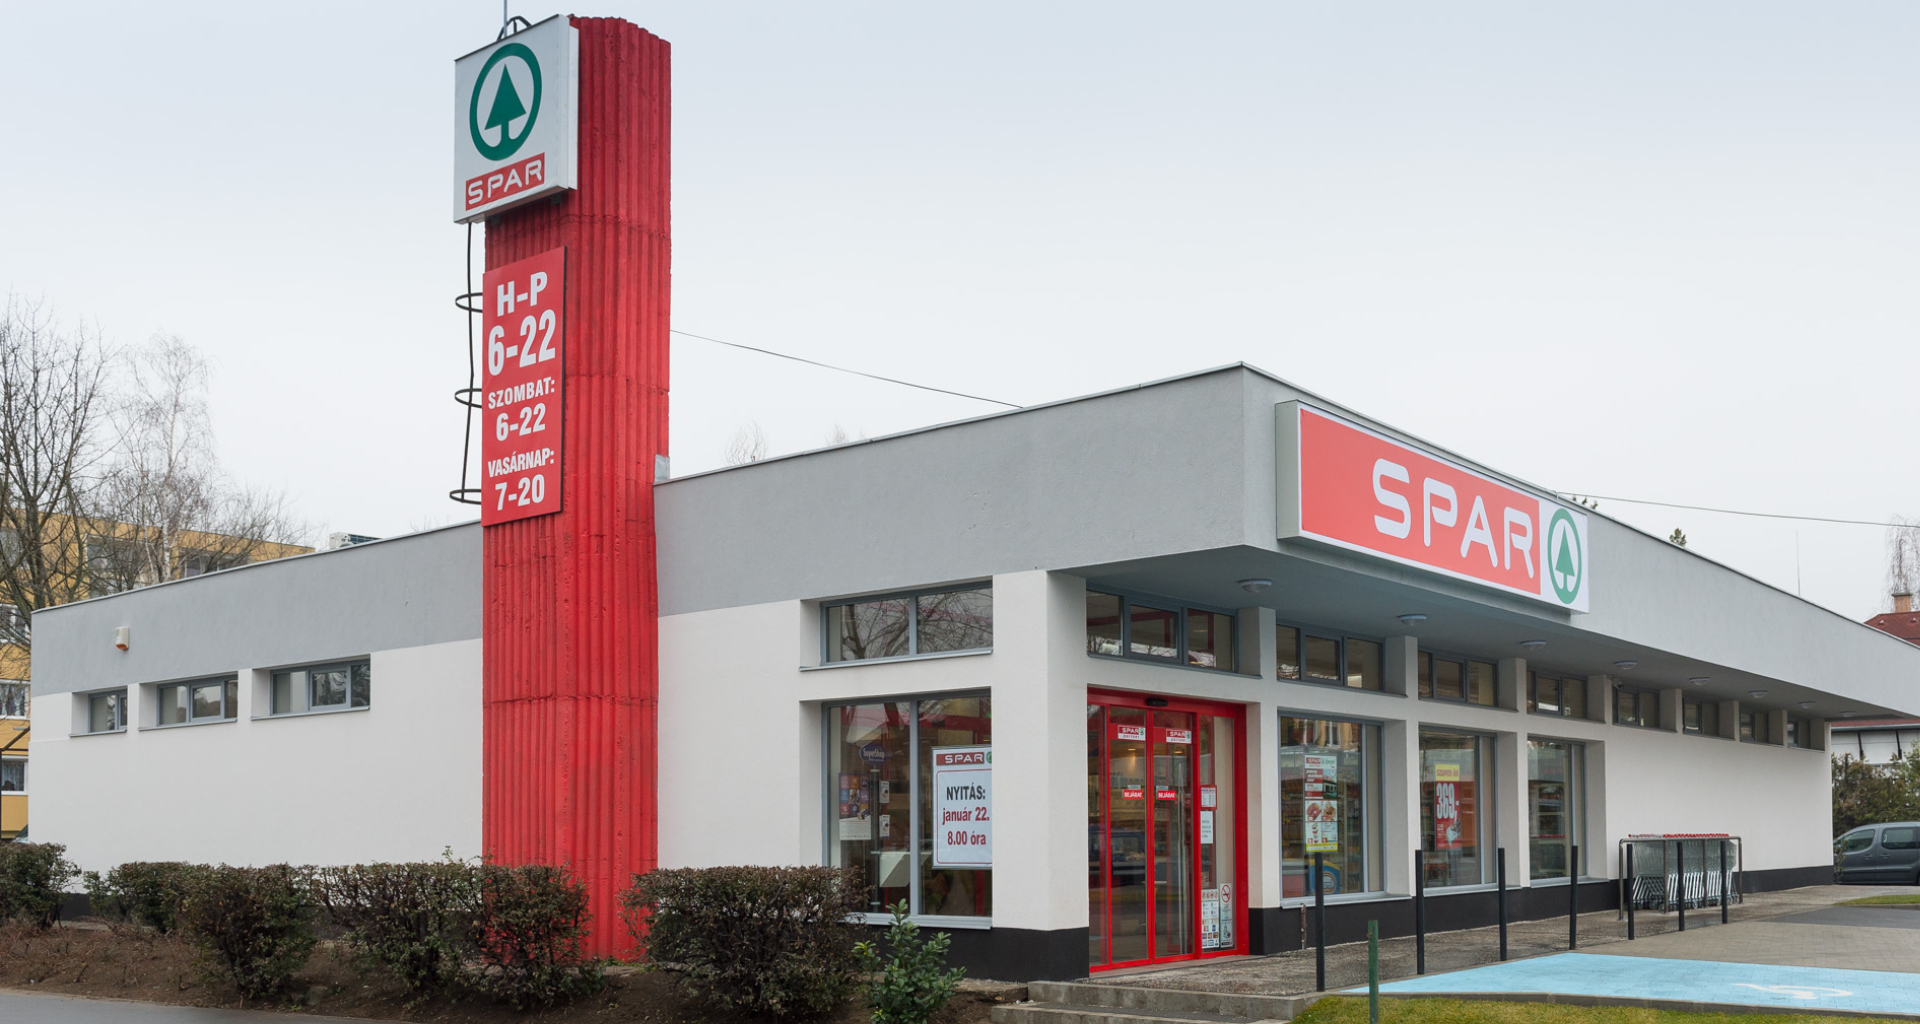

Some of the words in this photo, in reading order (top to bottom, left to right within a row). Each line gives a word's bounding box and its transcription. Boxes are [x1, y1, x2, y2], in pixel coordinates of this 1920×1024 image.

[468, 159, 542, 205] SPAR
[497, 271, 548, 317] H-P
[488, 309, 556, 376] 6-22
[488, 376, 555, 410] SZOMBAT:
[496, 402, 546, 441] 6-22
[487, 447, 555, 478] VASÁRNAP:
[495, 473, 545, 511] 7-20
[1372, 458, 1534, 579] SPAR
[944, 753, 984, 764] SPAR
[946, 782, 986, 801] NYITÁS:
[1124, 790, 1142, 798] BEJÁRAT
[1158, 791, 1175, 799] BEJÁRAT
[942, 807, 972, 826] január
[975, 806, 990, 822] 22.
[947, 831, 968, 846] 8.00
[970, 831, 987, 846] óra
